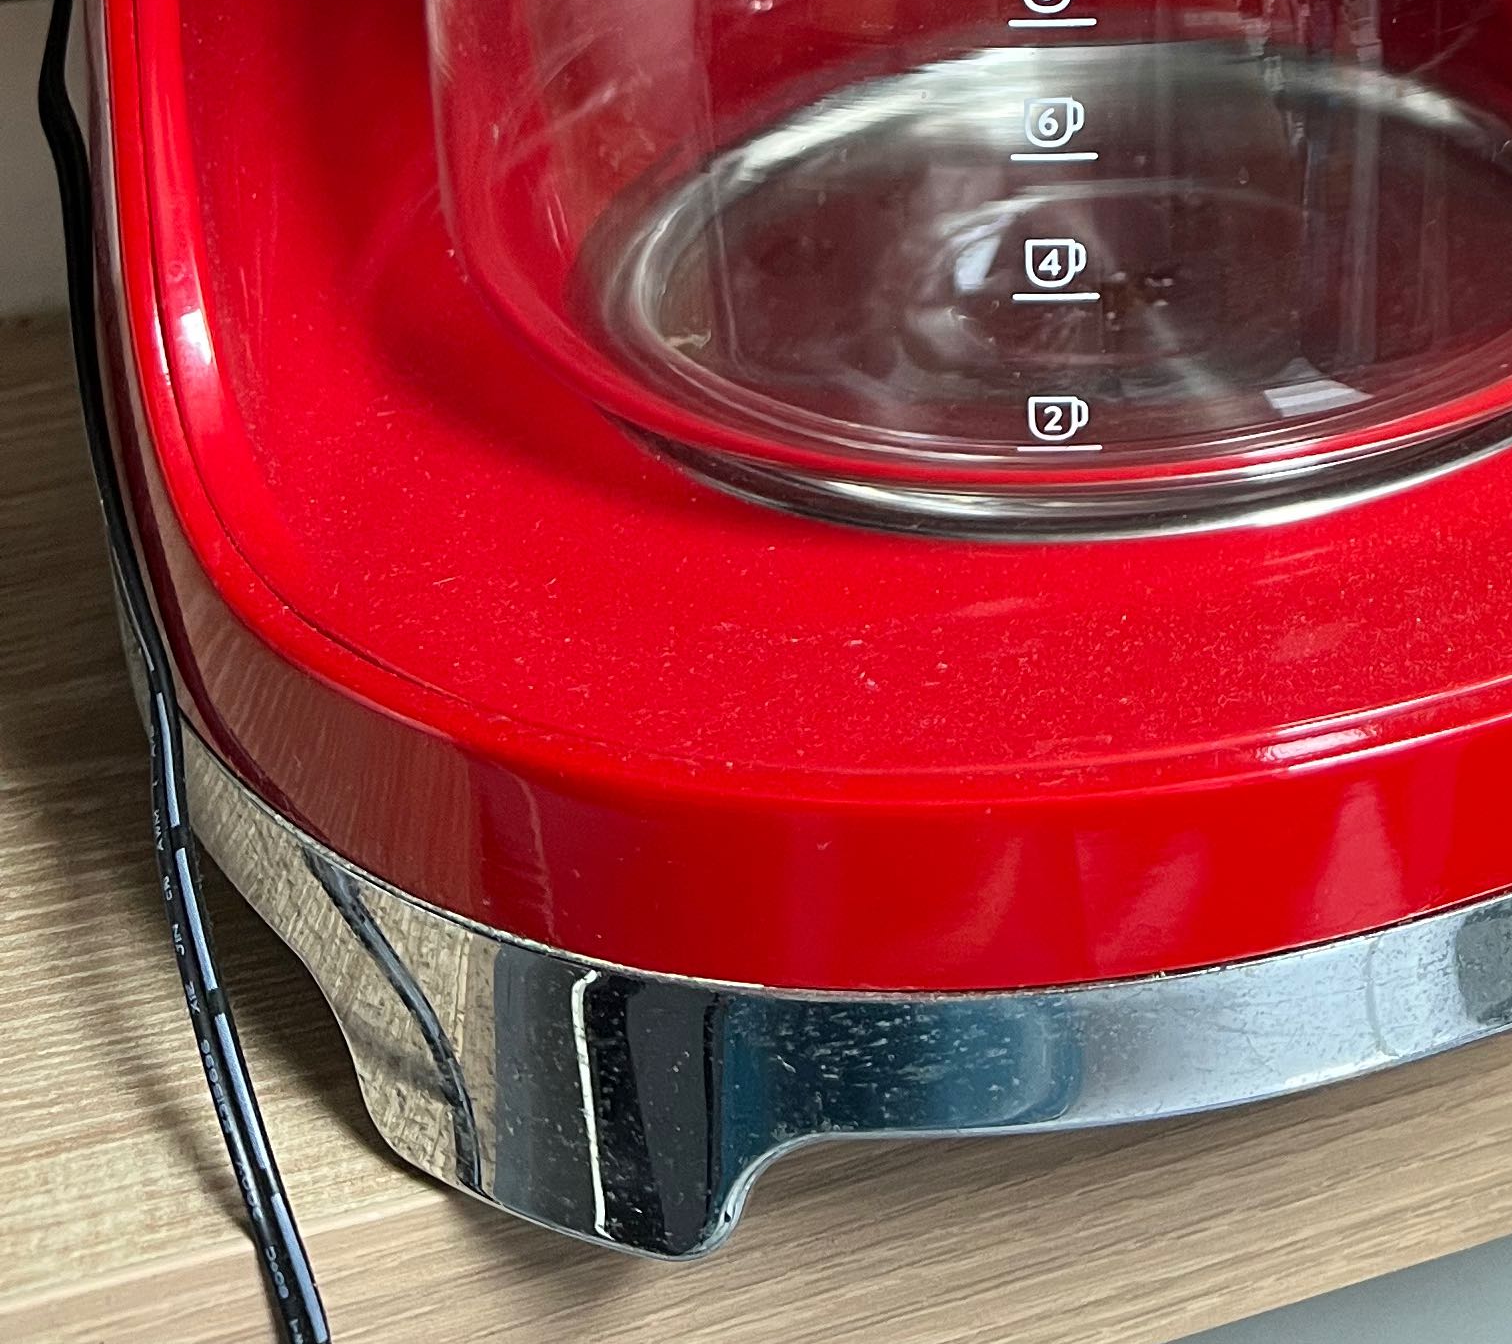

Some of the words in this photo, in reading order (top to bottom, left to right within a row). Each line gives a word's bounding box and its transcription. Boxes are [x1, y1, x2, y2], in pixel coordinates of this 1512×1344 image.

[1038, 107, 1058, 135] 6
[1038, 248, 1061, 275] 4
[1043, 406, 1062, 431] 2
